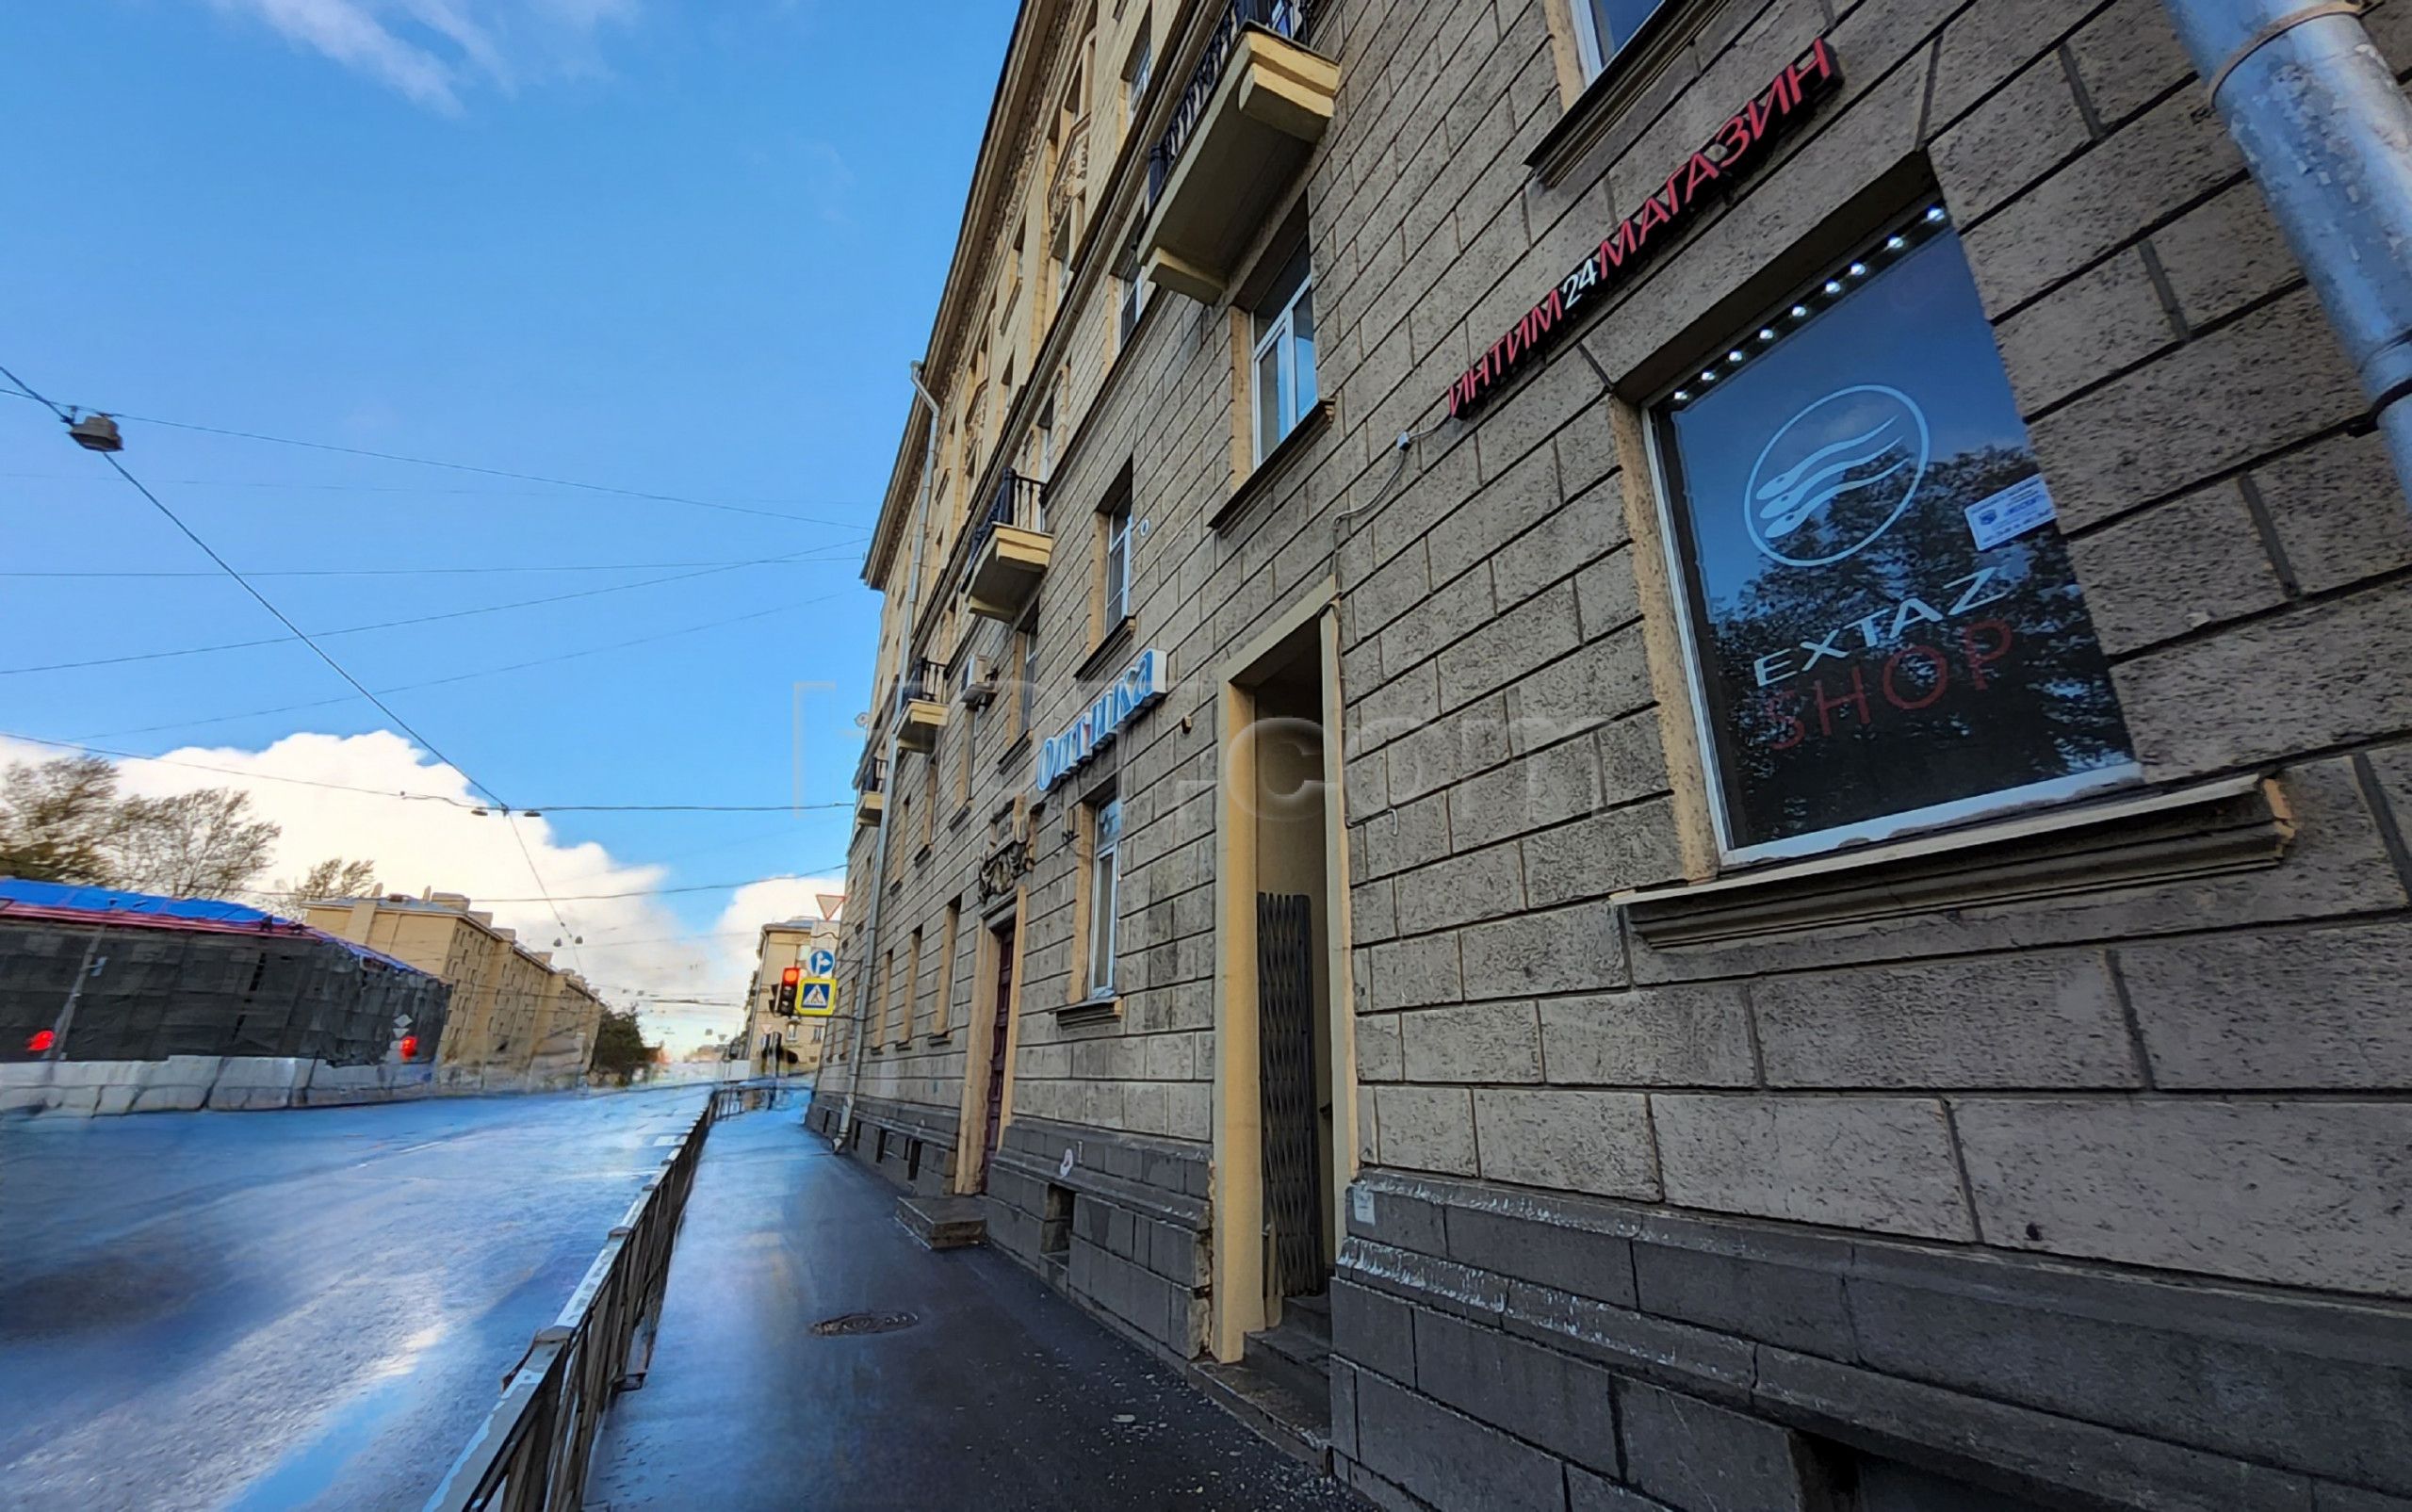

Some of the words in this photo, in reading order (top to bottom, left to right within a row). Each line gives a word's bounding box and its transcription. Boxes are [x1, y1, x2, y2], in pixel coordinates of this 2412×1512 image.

[1447, 288, 1564, 416] ИНТИМ
[1560, 258, 1598, 310] 24
[1595, 37, 1833, 279] МАГАЗИН
[1753, 566, 2007, 688] EXTAZ
[1766, 618, 2013, 751] SHOP
